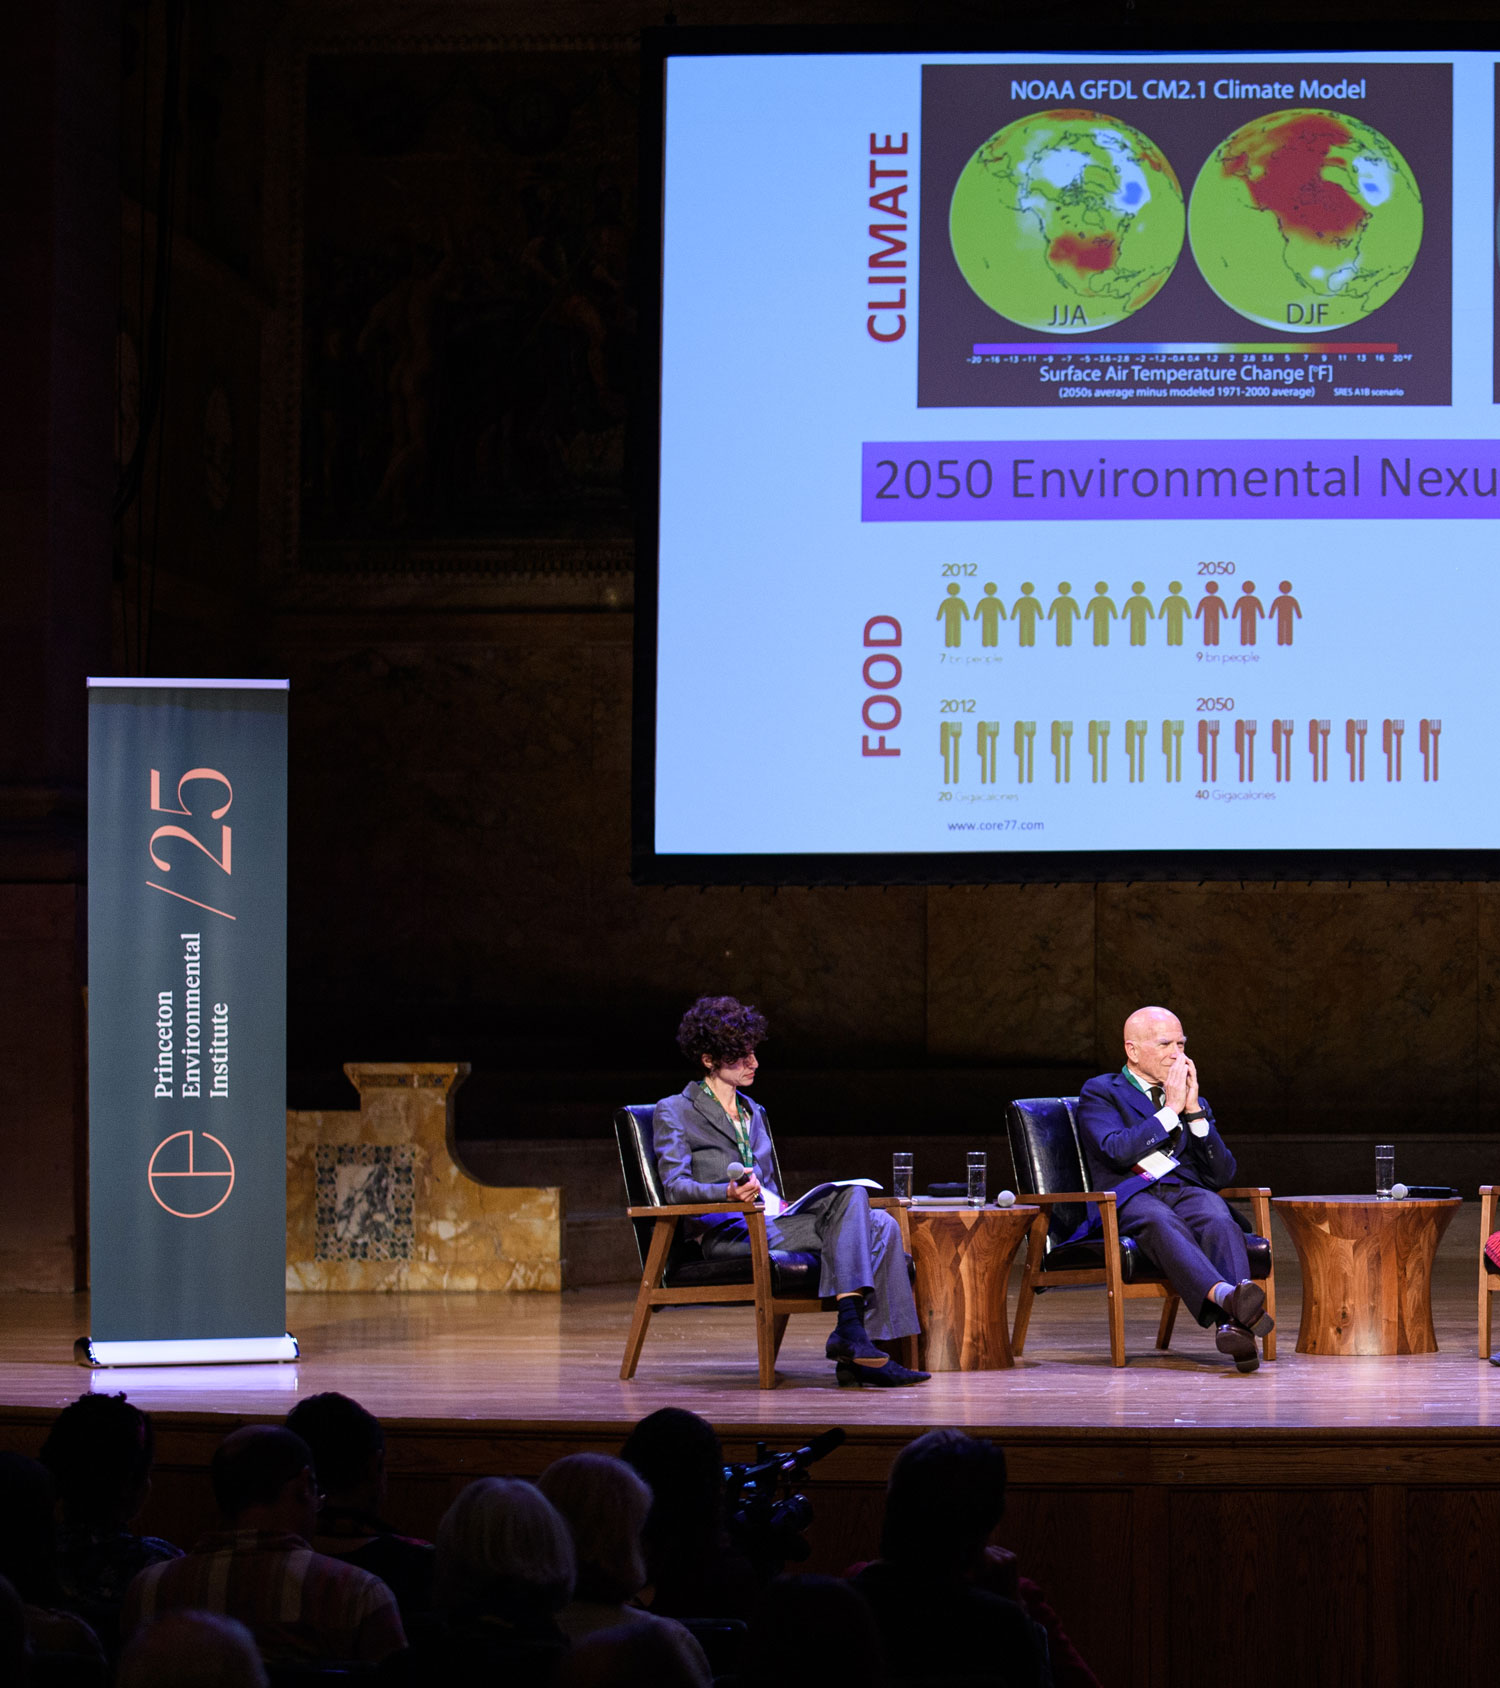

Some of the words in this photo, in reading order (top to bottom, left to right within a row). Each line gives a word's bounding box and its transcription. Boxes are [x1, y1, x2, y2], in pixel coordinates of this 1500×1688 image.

[1011, 80, 1075, 100] NOAA
[1080, 79, 1138, 100] GFDL
[1142, 79, 1206, 100] CM2.1
[1213, 79, 1295, 100] Climate
[1300, 78, 1366, 99] Model
[866, 131, 908, 343] CLIMATE
[1047, 304, 1088, 328] JJA
[1286, 303, 1330, 326] DJF
[1040, 365, 1102, 382] Surface
[1105, 365, 1129, 381] Air
[1131, 365, 1237, 384] Temperature
[1240, 365, 1305, 384] Change
[1058, 386, 1093, 399] (2050s
[1094, 388, 1134, 400] average
[1136, 387, 1168, 398] minus
[1169, 386, 1215, 398] modeled
[1217, 386, 1270, 397] 1971-2000
[1272, 386, 1315, 399] average)
[1333, 388, 1353, 396] SRES
[1354, 388, 1370, 396] A1B
[1371, 387, 1404, 396] scenario
[874, 458, 994, 499] 2050
[1011, 456, 1360, 497] Environmental
[941, 563, 978, 577] 2012
[1197, 561, 1236, 576] 2050
[1196, 651, 1203, 662] 9
[1222, 651, 1260, 665] people
[861, 614, 903, 758] FOOD
[940, 699, 976, 714] 2012
[1196, 697, 1235, 712] 2050
[939, 791, 953, 802] 20
[1195, 789, 1210, 800] 40
[1212, 789, 1277, 804] Gigacalories
[948, 820, 1045, 831] www.core77.com
[182, 932, 200, 1099] Environmental
[154, 990, 174, 1099] Princeton
[209, 1002, 229, 1099] Institute
